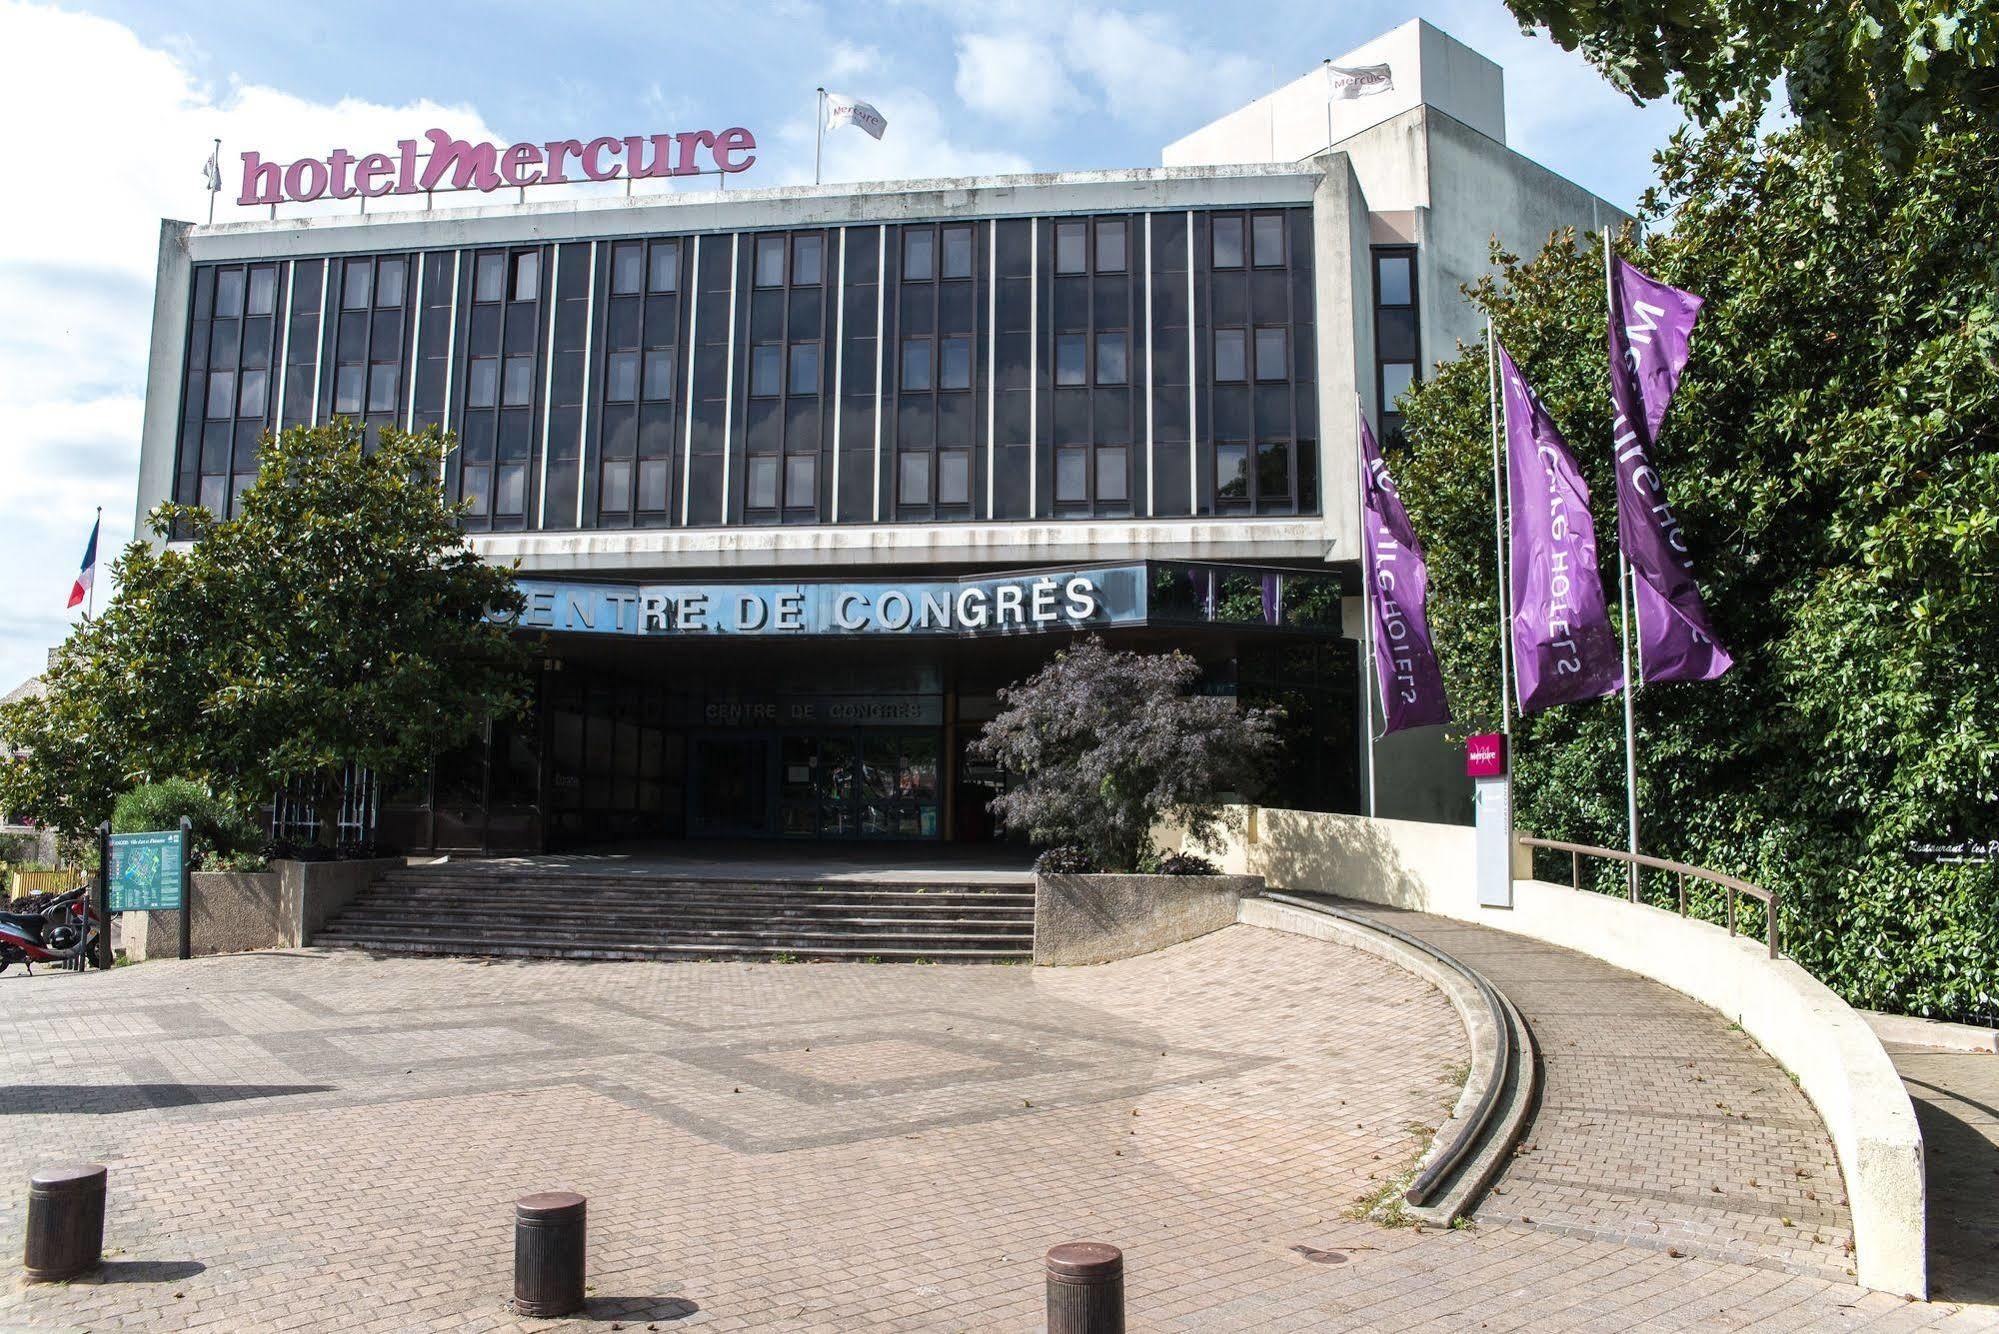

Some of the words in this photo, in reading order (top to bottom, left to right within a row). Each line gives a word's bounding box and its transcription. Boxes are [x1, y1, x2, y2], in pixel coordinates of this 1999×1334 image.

[833, 105, 879, 125] Mercure
[237, 139, 419, 206] hotel
[734, 592, 802, 632] DE
[834, 576, 1095, 631] CONGRÈS
[706, 703, 777, 719] CENTRE
[792, 703, 816, 720] DE
